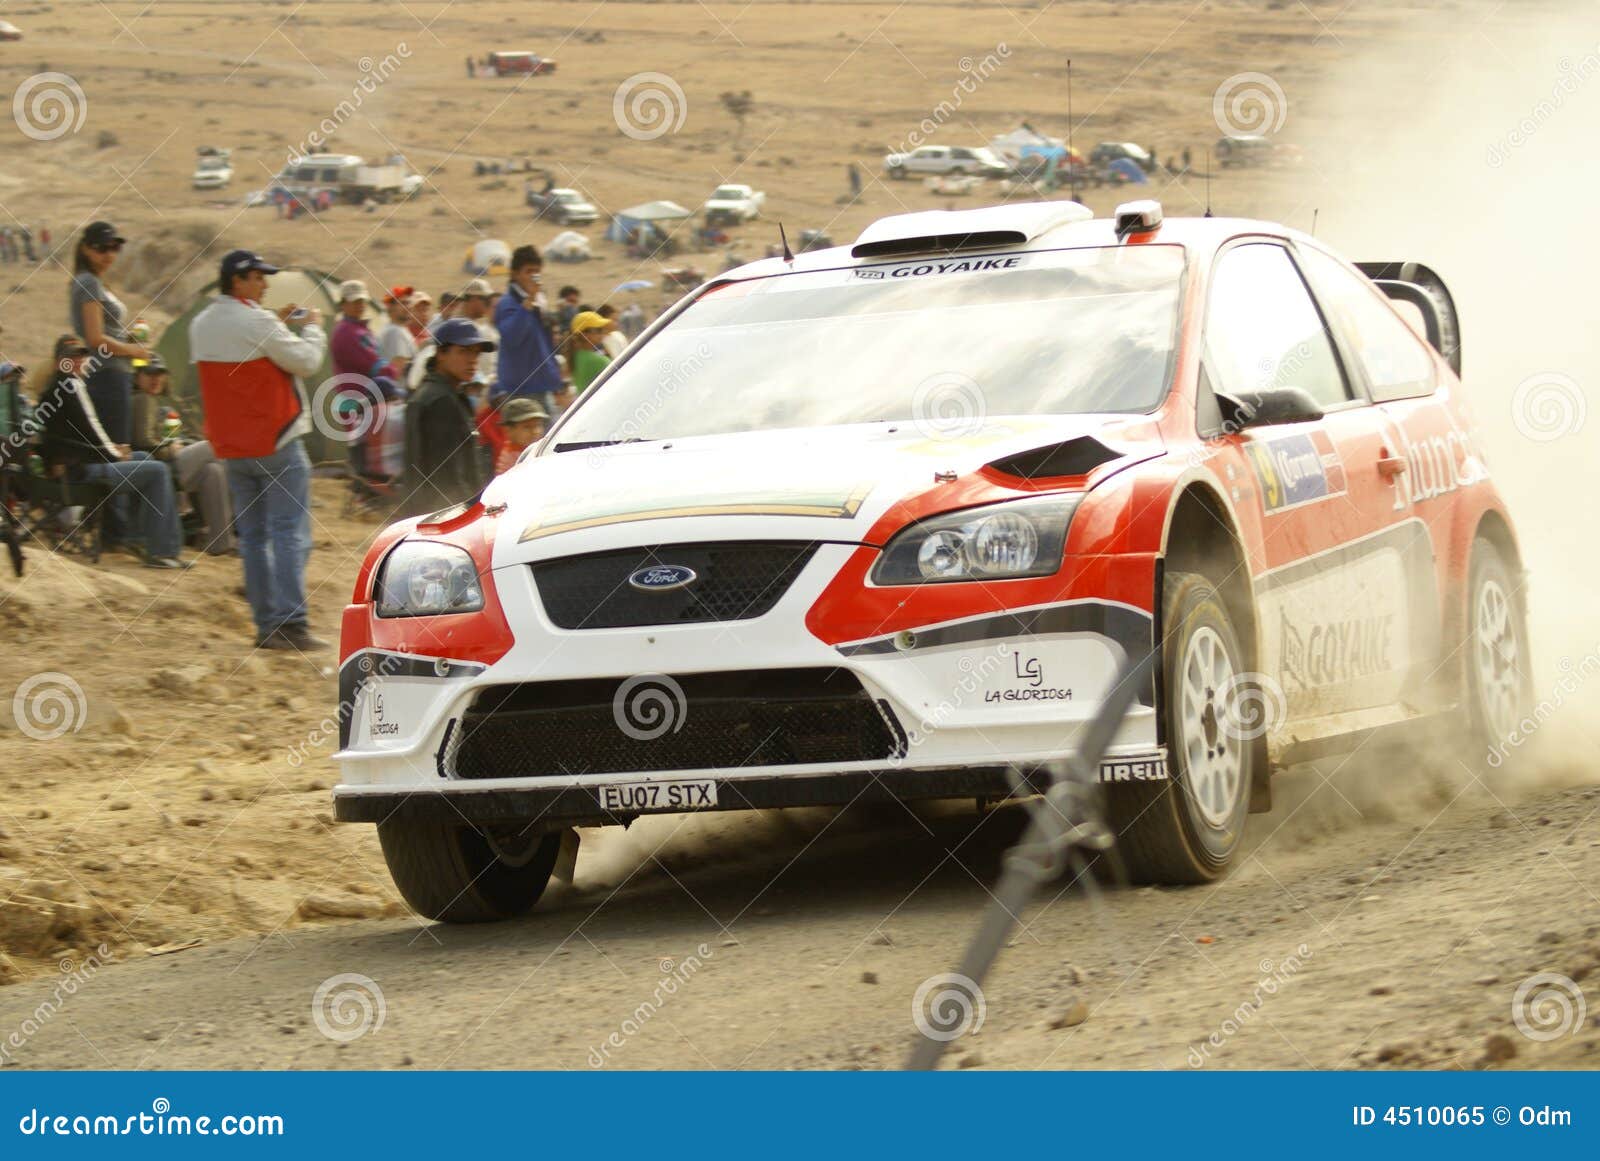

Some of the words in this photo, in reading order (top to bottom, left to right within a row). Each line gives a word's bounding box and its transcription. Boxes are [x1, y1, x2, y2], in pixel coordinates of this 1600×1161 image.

[891, 257, 1021, 278] GOYAIKE
[643, 569, 679, 584] Ford
[984, 689, 1001, 703] LA
[1002, 688, 1073, 701] GLORIOSA
[604, 786, 660, 809] EU07
[667, 783, 712, 806] STX
